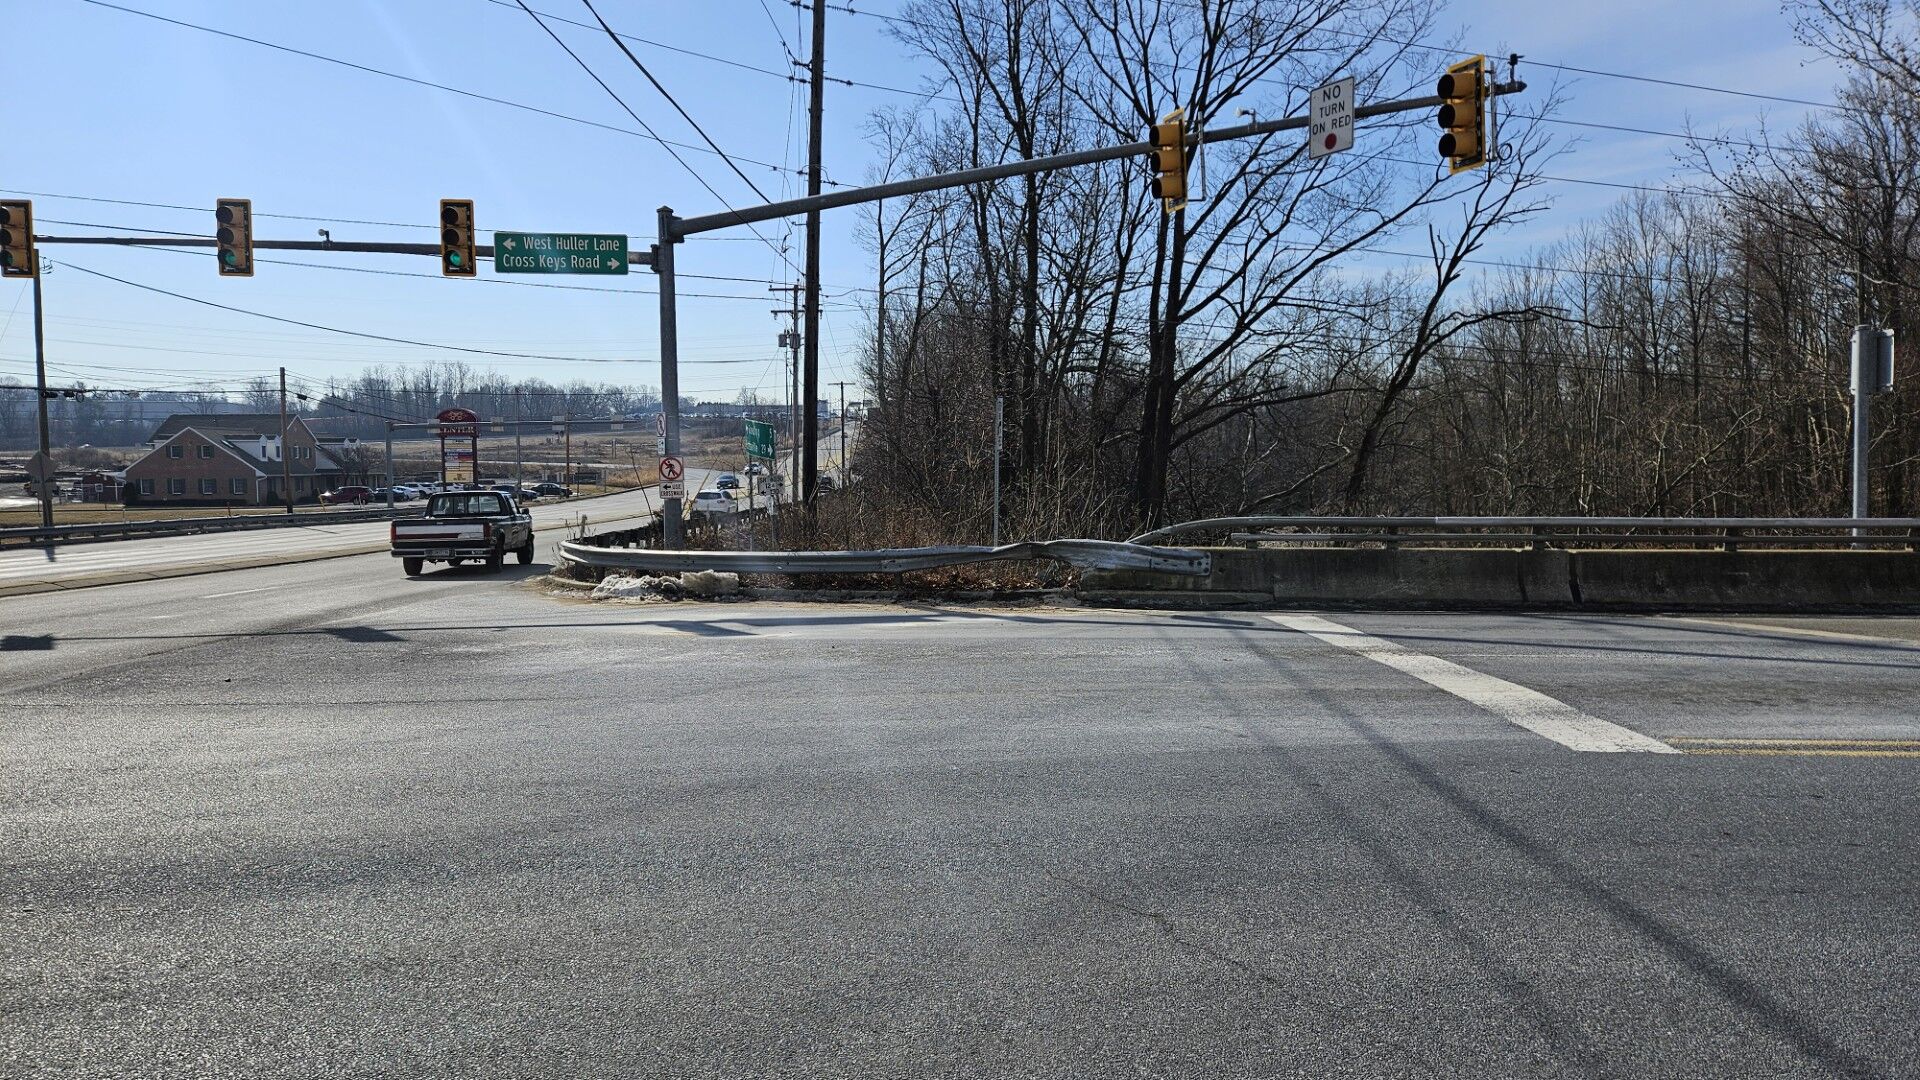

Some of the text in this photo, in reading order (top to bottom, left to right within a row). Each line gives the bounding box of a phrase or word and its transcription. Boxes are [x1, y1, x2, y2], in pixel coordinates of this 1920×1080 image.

[1323, 85, 1341, 102] NO
[1320, 101, 1345, 118] TURN
[1312, 115, 1351, 135] ON RED
[523, 236, 620, 251] West Huller Lane
[503, 253, 600, 272] Cross Keys Road
